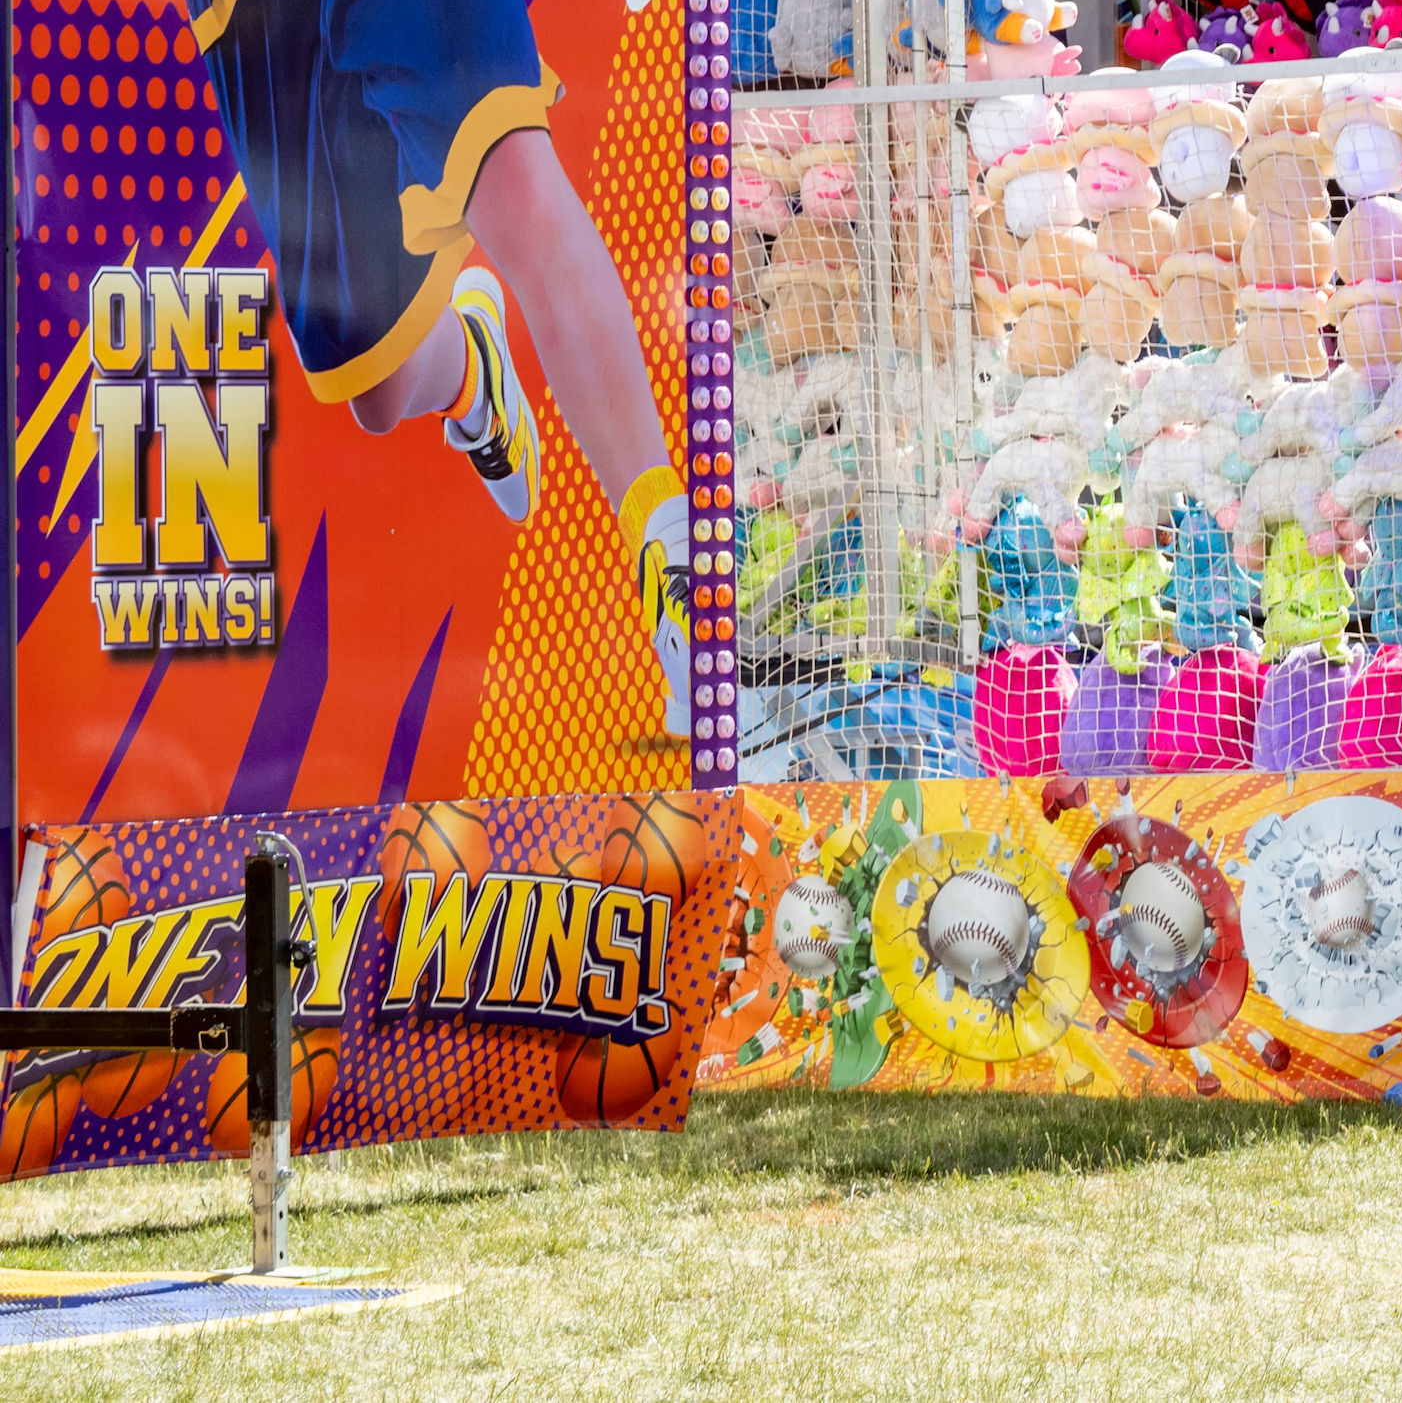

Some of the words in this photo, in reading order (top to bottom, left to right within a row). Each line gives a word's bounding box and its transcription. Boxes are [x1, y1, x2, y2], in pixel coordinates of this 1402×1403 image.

[88, 265, 270, 377] ONE
[91, 382, 271, 573] IN
[91, 571, 276, 650] WINS!
[15, 894, 248, 1053] ONE
[382, 871, 673, 1045] WINS!
